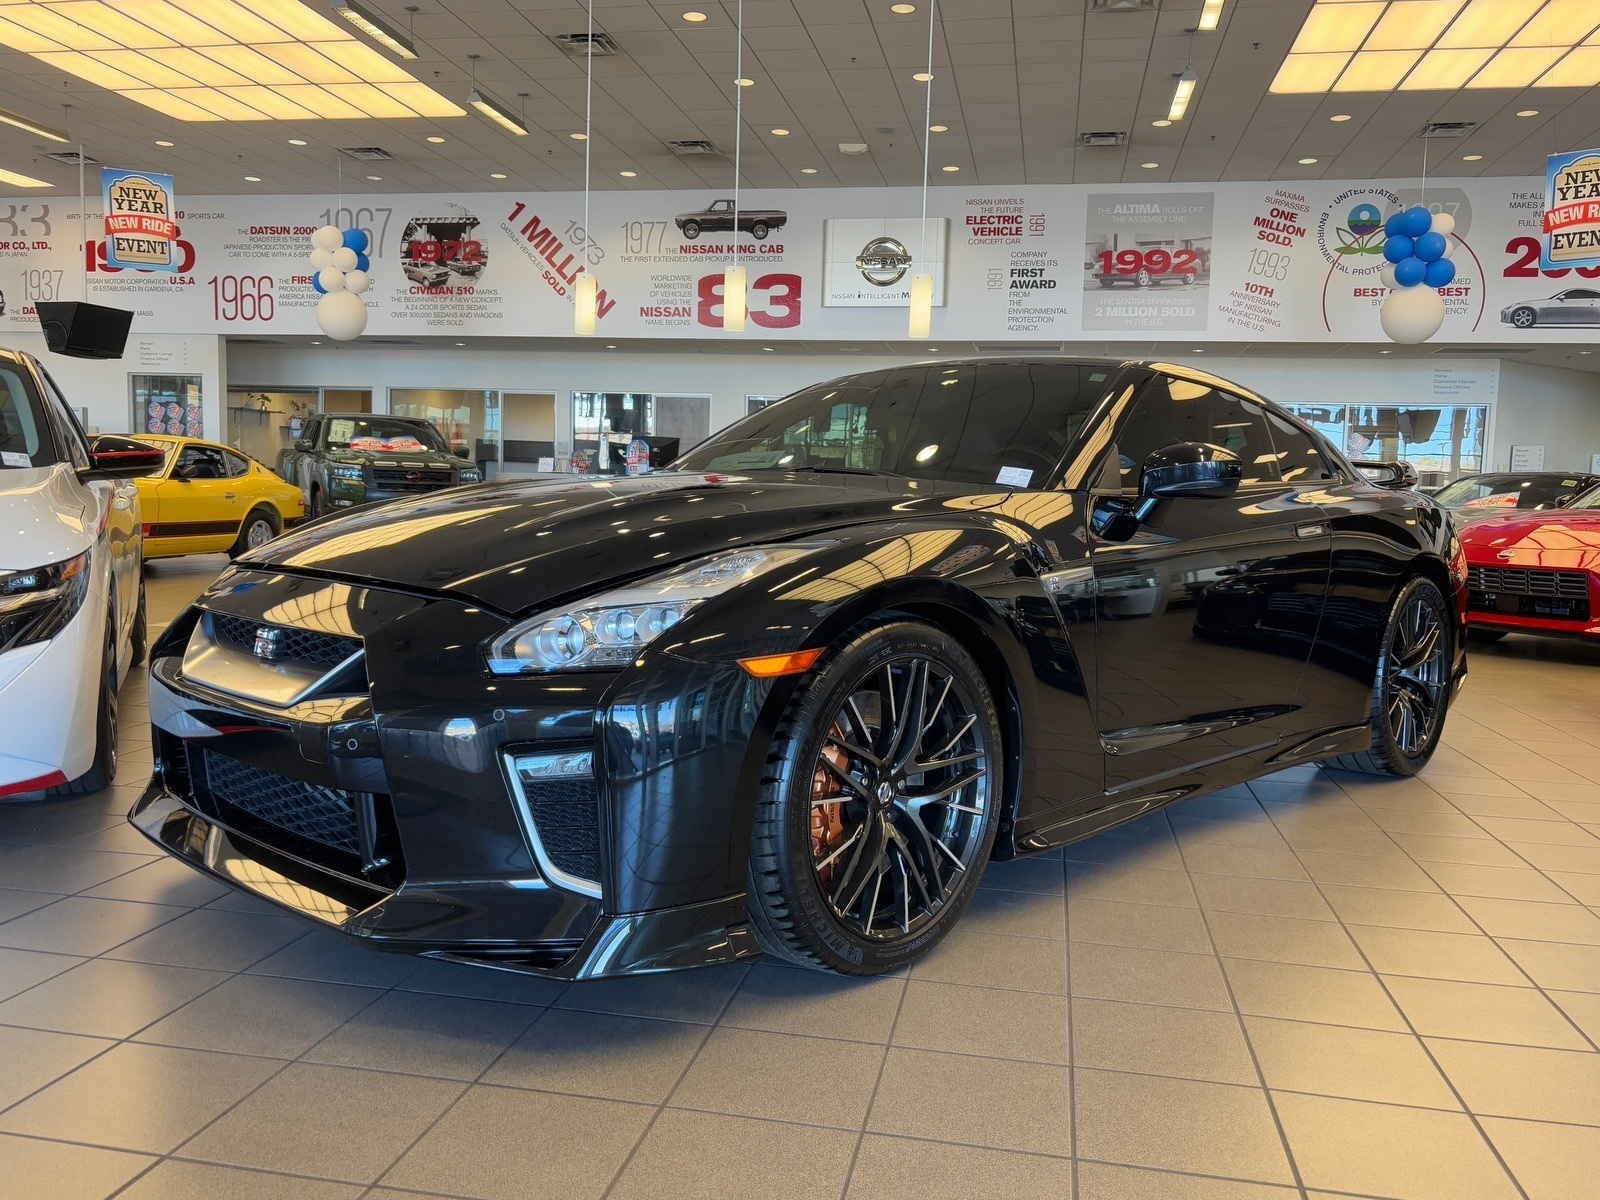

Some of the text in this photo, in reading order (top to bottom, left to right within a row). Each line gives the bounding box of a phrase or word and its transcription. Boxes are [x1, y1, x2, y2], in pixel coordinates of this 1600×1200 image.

[118, 187, 159, 201] NEW
[1274, 189, 1305, 202] MAXIMA
[1511, 192, 1528, 200] THE
[113, 198, 165, 214] YEAR
[1113, 204, 1160, 214] ALTIMA
[1264, 196, 1310, 213] SURPASSES
[1509, 201, 1538, 209] MAKES
[965, 215, 1023, 225] ELECTRIC
[1269, 207, 1298, 223] ONE
[1518, 219, 1538, 227] FULL
[1548, 205, 1584, 227] NEW
[107, 218, 172, 234] NEW RIDE
[250, 226, 291, 235] DATSUN
[972, 227, 1023, 236] VEHICLE
[1029, 212, 1045, 236] 1991
[1253, 216, 1306, 237] MILLION
[563, 219, 605, 266] 1973
[620, 221, 668, 254] 1977
[1257, 230, 1293, 247] SOLD.
[1317, 212, 1350, 275] ENVIRONMENTAL
[12, 242, 52, 252] CO., LTD.,
[115, 237, 167, 255] EVENT
[223, 243, 292, 251] JAPANESE-PRODUCTION
[406, 240, 482, 262] 1972
[680, 245, 724, 254] NISSAN
[759, 245, 785, 254] CAB
[500, 222, 566, 296] DATSUN VEHICLES SOLD
[508, 201, 616, 319] 1 MILLIN
[861, 256, 907, 265] NISSAN
[1098, 249, 1198, 275] 1992
[1247, 248, 1290, 281] 1993
[169, 276, 196, 285] U.S.A
[987, 268, 1003, 292] 1991
[1010, 268, 1045, 278] FIRST
[20, 269, 64, 301] 1937
[409, 286, 453, 295] CIVILIAN
[456, 286, 475, 295] 510
[654, 282, 692, 290] MARKETING
[1009, 279, 1057, 289] AWARD
[1244, 282, 1275, 298] 10TH
[1437, 287, 1471, 296] BEST
[207, 275, 274, 321] 1966
[659, 290, 692, 298] VEHICLES
[1229, 290, 1281, 309] ANNIVERSARY
[1353, 288, 1386, 297] BEST
[697, 273, 802, 330] 83
[1232, 300, 1273, 316] OF NISSAN
[640, 307, 691, 318] NISSAN
[1094, 307, 1196, 317] 2 MILLION SOLD
[1217, 305, 1281, 328] MANUFACTURING
[1236, 318, 1251, 328] THE
